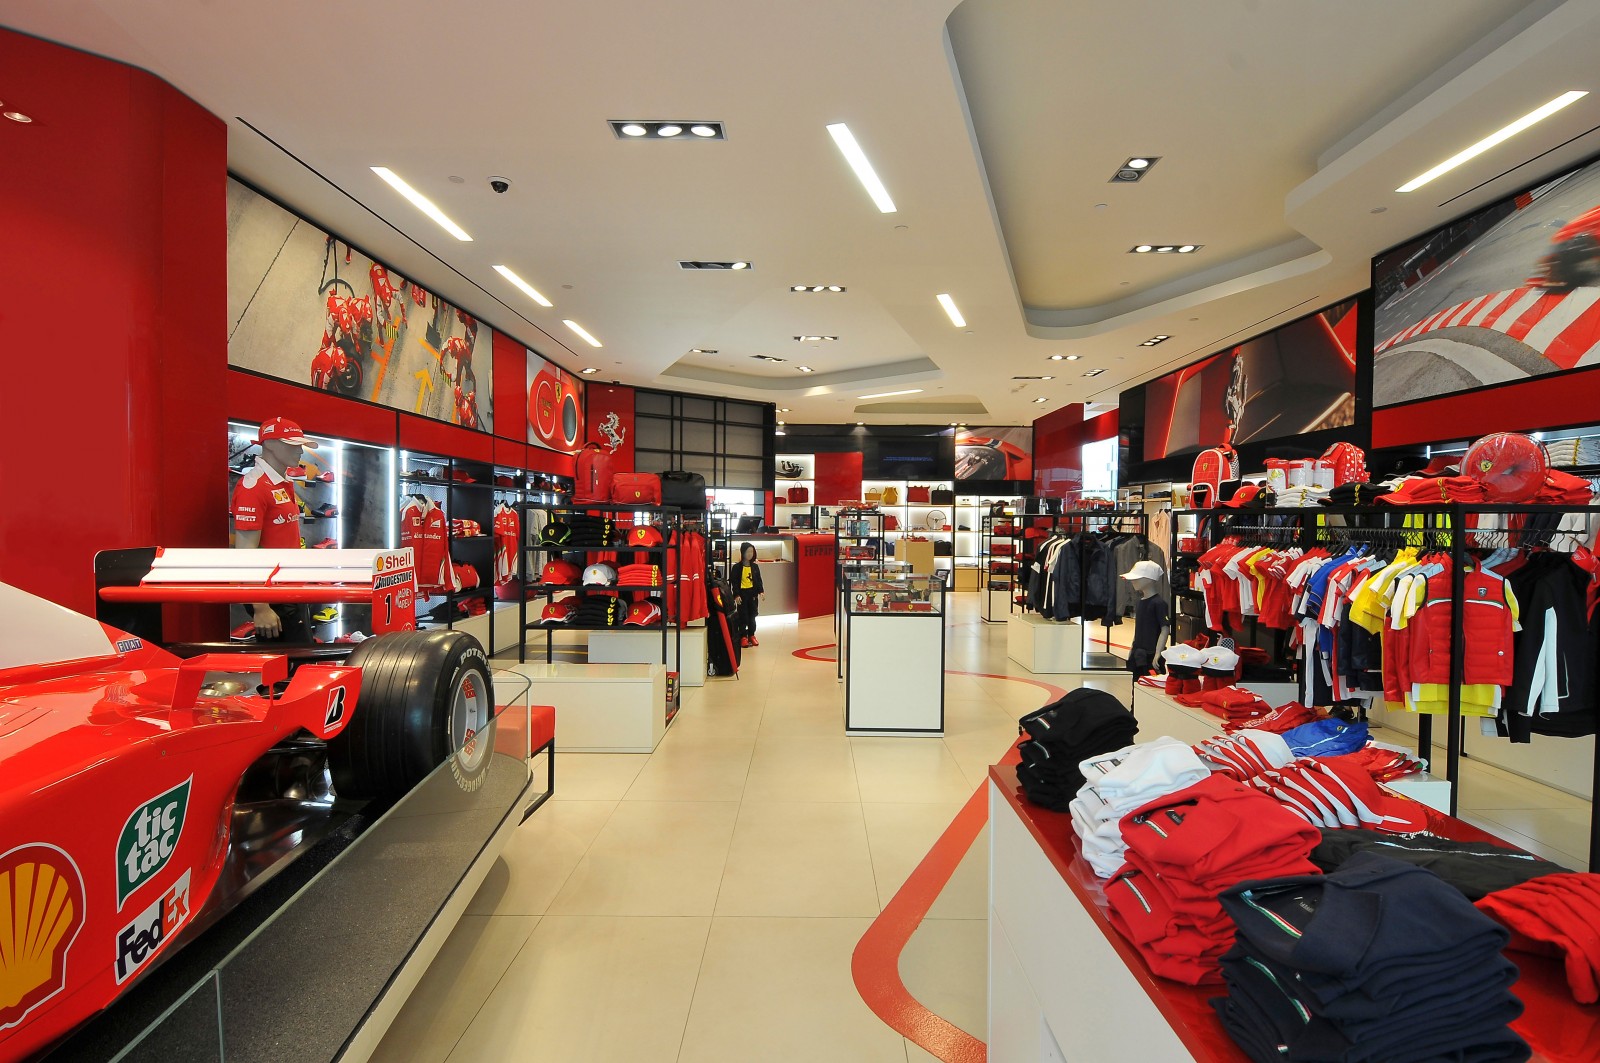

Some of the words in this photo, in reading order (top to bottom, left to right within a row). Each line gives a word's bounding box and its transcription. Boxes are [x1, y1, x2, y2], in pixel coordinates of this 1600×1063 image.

[385, 552, 411, 570] Shell
[374, 570, 412, 590] BRIDGESTONE
[385, 593, 392, 626] 1
[116, 638, 143, 653] FIAT
[134, 801, 178, 848] tic
[124, 828, 175, 884] tac
[116, 886, 188, 980] FedEx
